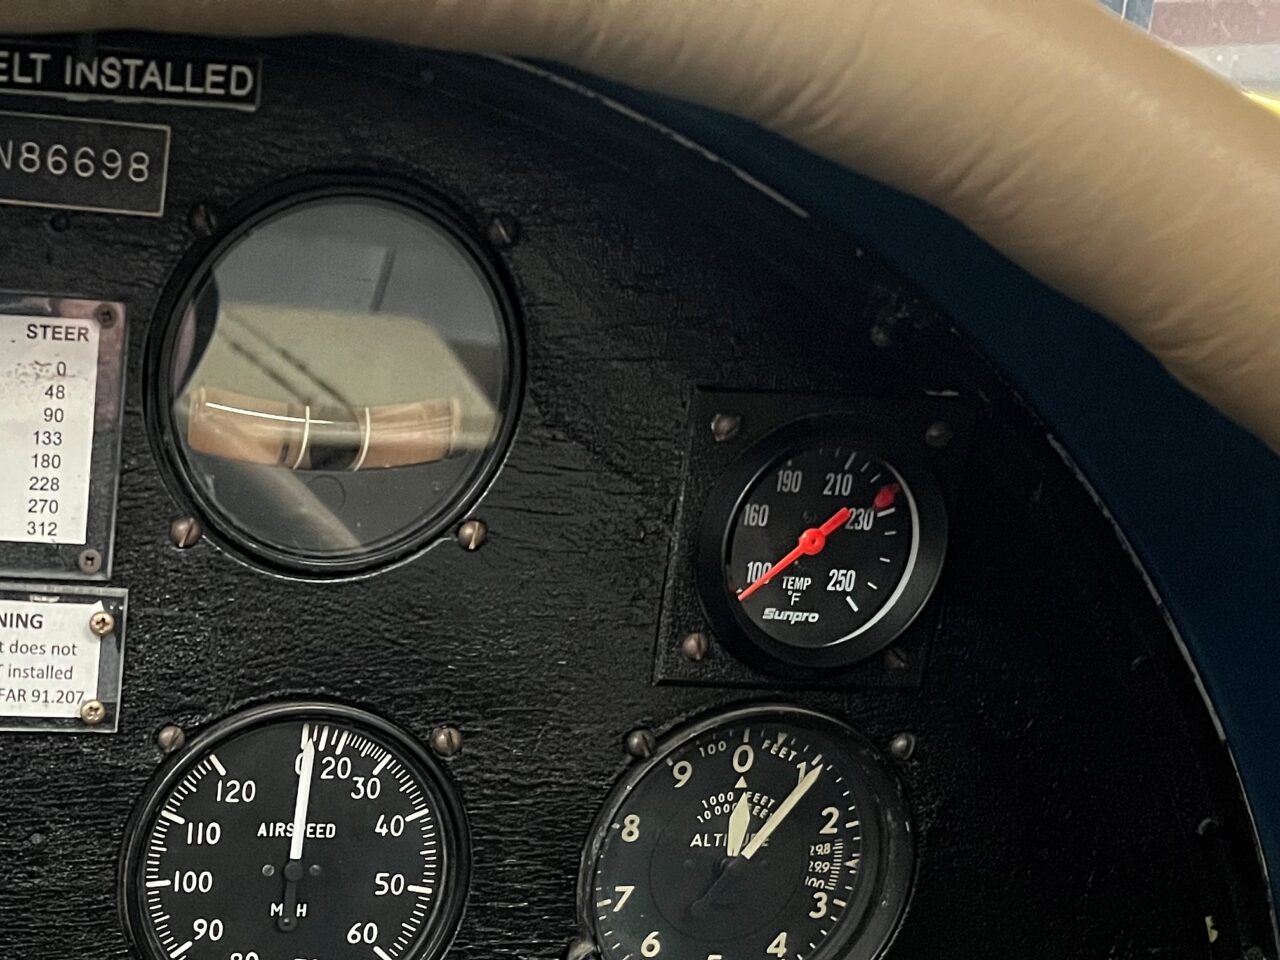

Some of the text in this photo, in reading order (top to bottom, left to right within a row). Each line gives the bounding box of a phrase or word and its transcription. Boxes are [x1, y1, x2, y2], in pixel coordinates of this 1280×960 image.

[65, 55, 253, 96] INSTALLED
[26, 324, 89, 342] STEER
[57, 362, 67, 376] 0
[45, 385, 65, 400] 48
[43, 408, 64, 423] 90
[33, 431, 62, 446] 133
[32, 454, 61, 469] 180
[29, 477, 60, 492] 228
[777, 470, 802, 493] 190
[823, 473, 852, 496] 210
[28, 499, 58, 514] 270
[744, 504, 769, 526] 160
[26, 522, 58, 537] 312
[846, 508, 874, 530] 230
[747, 561, 772, 584] 100
[783, 576, 811, 590] TEMP
[827, 569, 856, 591] 250
[762, 608, 819, 624] Sunpro
[9, 640, 46, 655] does
[51, 643, 78, 656] not
[7, 664, 73, 680] installed
[31, 689, 85, 705] 91.207
[700, 740, 798, 761] 100 FEET
[732, 745, 754, 773] 0
[321, 756, 351, 780] 20
[672, 761, 692, 788] 9
[216, 780, 256, 802] 120
[351, 776, 380, 800] 30
[702, 792, 776, 809] 1000 FEET
[257, 823, 336, 838] AIRSEED
[375, 814, 404, 836] 40
[621, 814, 640, 842] 8
[820, 807, 839, 834] 2
[187, 822, 220, 845] 110
[174, 871, 212, 893] 100
[375, 873, 404, 895] 50
[270, 903, 307, 917] MH
[613, 886, 635, 912] 7
[809, 892, 828, 918] 3
[193, 918, 223, 940] 90
[346, 922, 378, 944] 60
[640, 931, 660, 958] 6
[767, 932, 788, 958] 4
